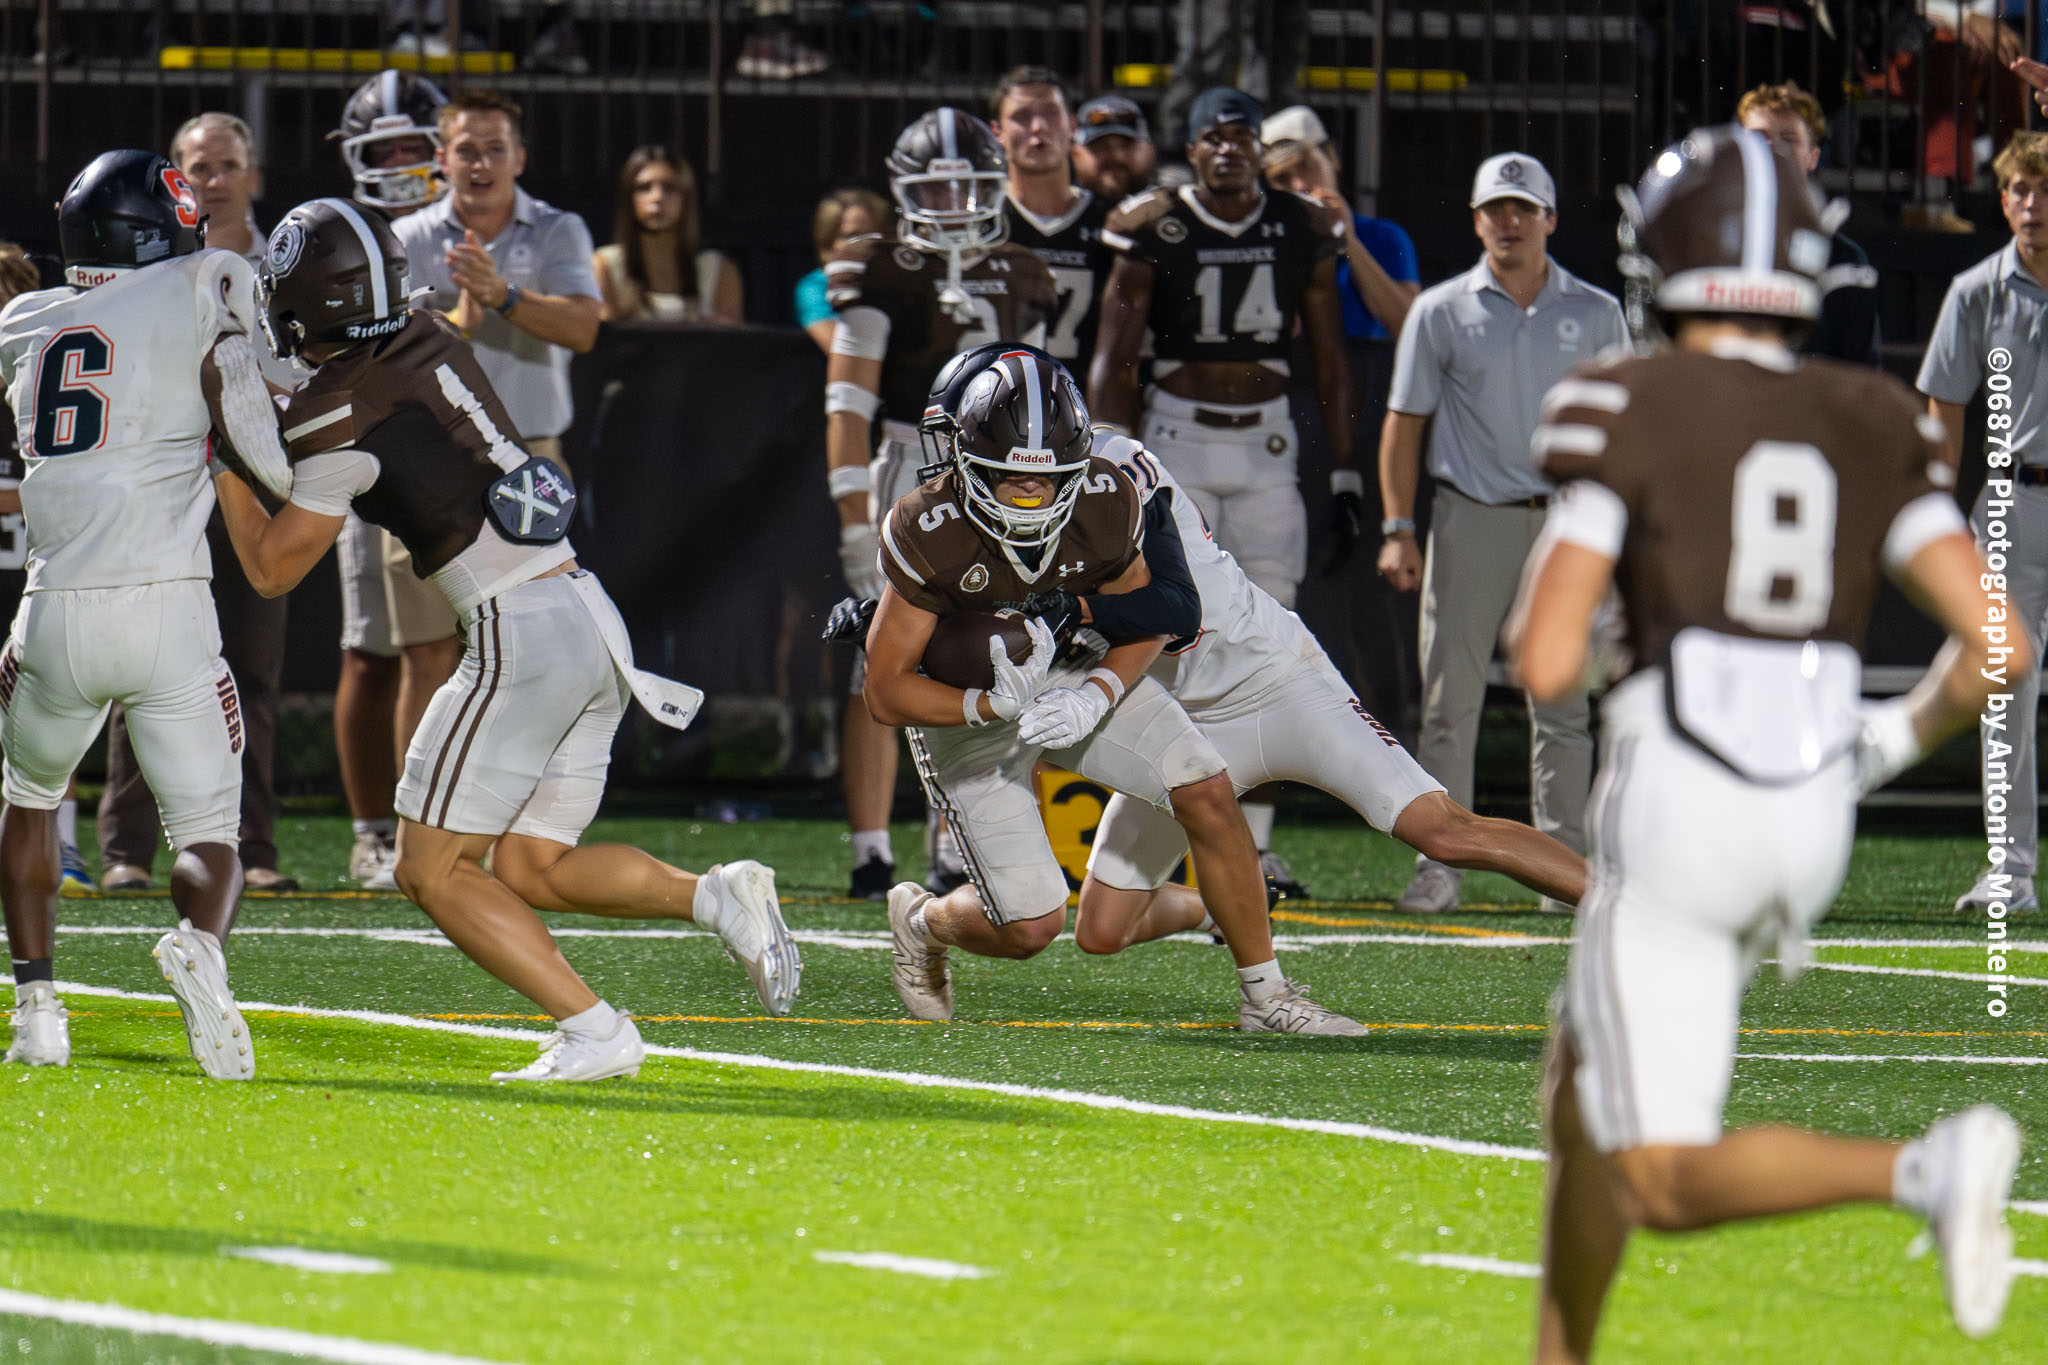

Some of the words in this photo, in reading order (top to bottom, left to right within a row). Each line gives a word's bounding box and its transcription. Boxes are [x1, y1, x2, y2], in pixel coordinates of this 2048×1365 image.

[160, 167, 199, 228] S
[346, 311, 407, 338] Riddell
[1194, 264, 1283, 342] 14
[30, 325, 114, 457] 6
[435, 362, 530, 475] 1
[1012, 452, 1052, 464] Riddell
[1082, 473, 1118, 494] 5
[918, 502, 960, 532] 5
[1724, 439, 1838, 636] 8
[215, 671, 242, 754] TIGERS
